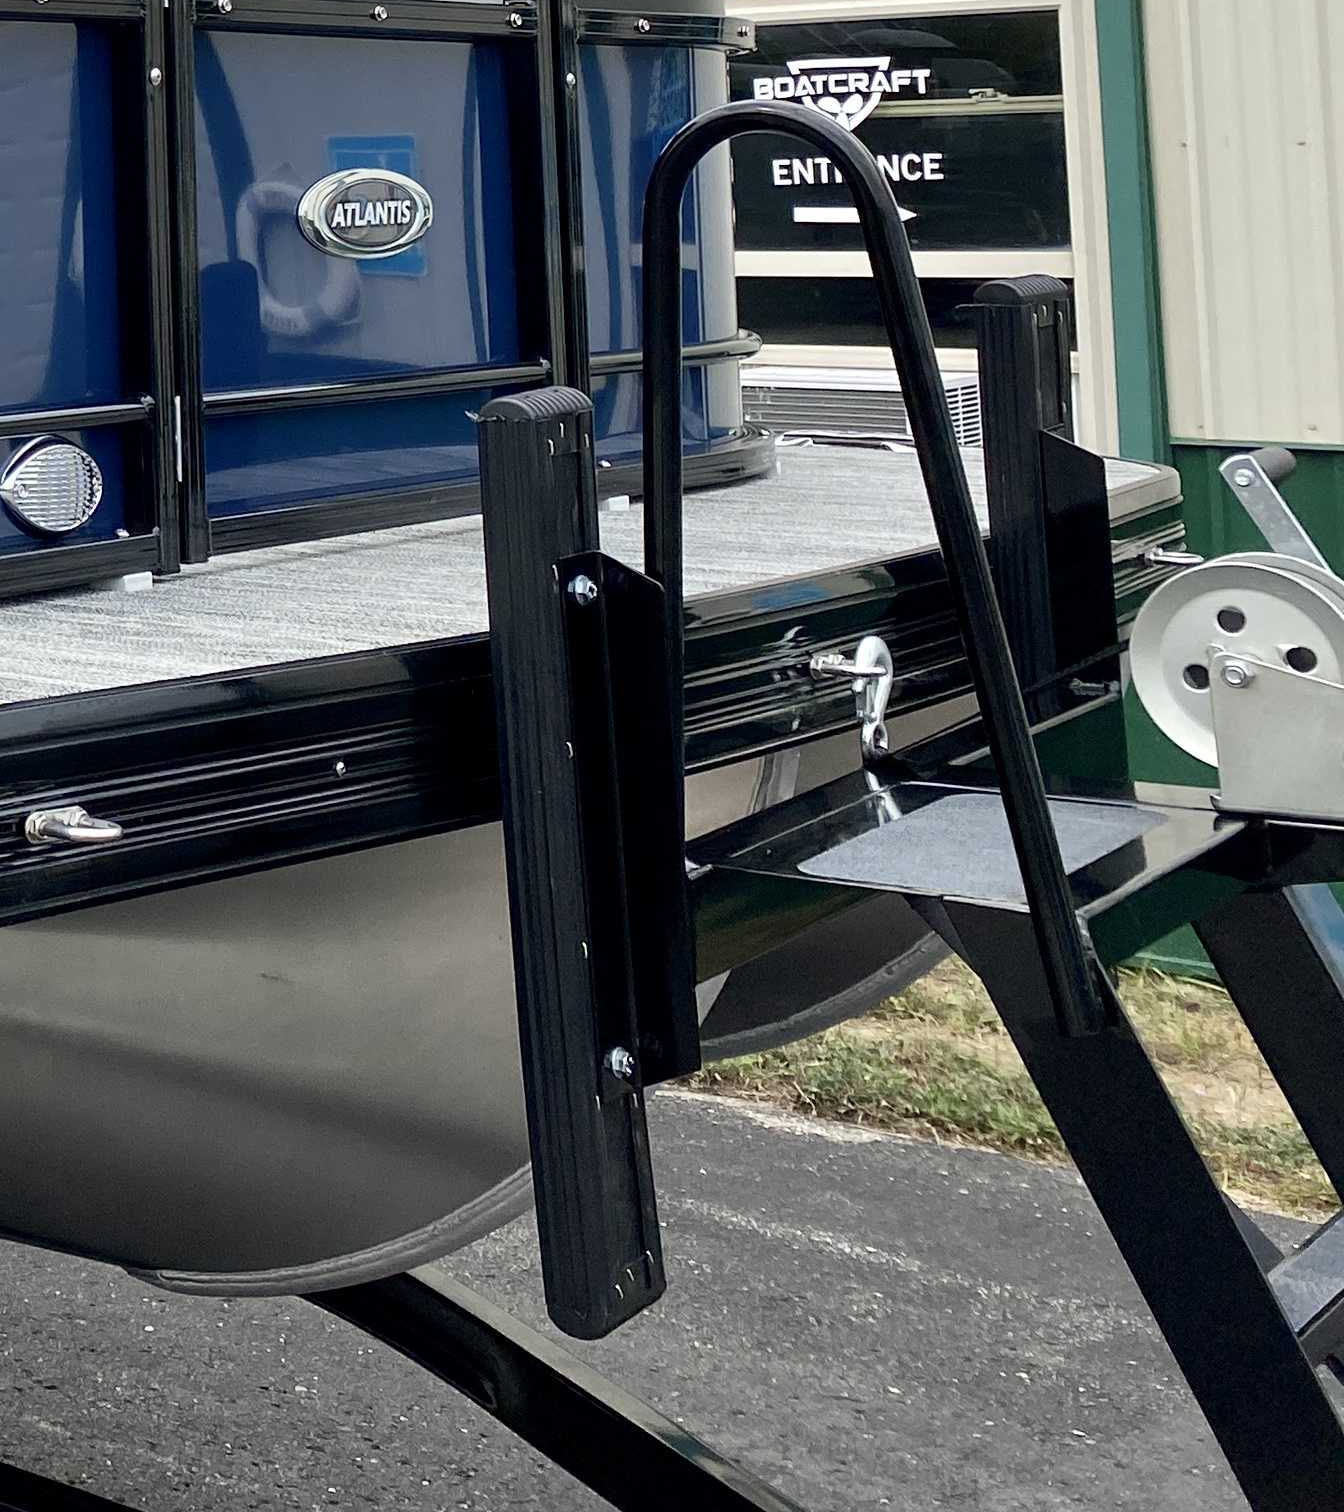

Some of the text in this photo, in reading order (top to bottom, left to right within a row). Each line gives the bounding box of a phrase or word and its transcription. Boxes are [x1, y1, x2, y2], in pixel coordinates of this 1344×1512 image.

[753, 69, 931, 100] BOATCRAFT
[772, 153, 944, 186] ENTNCE
[331, 199, 411, 228] ATLANTIS
